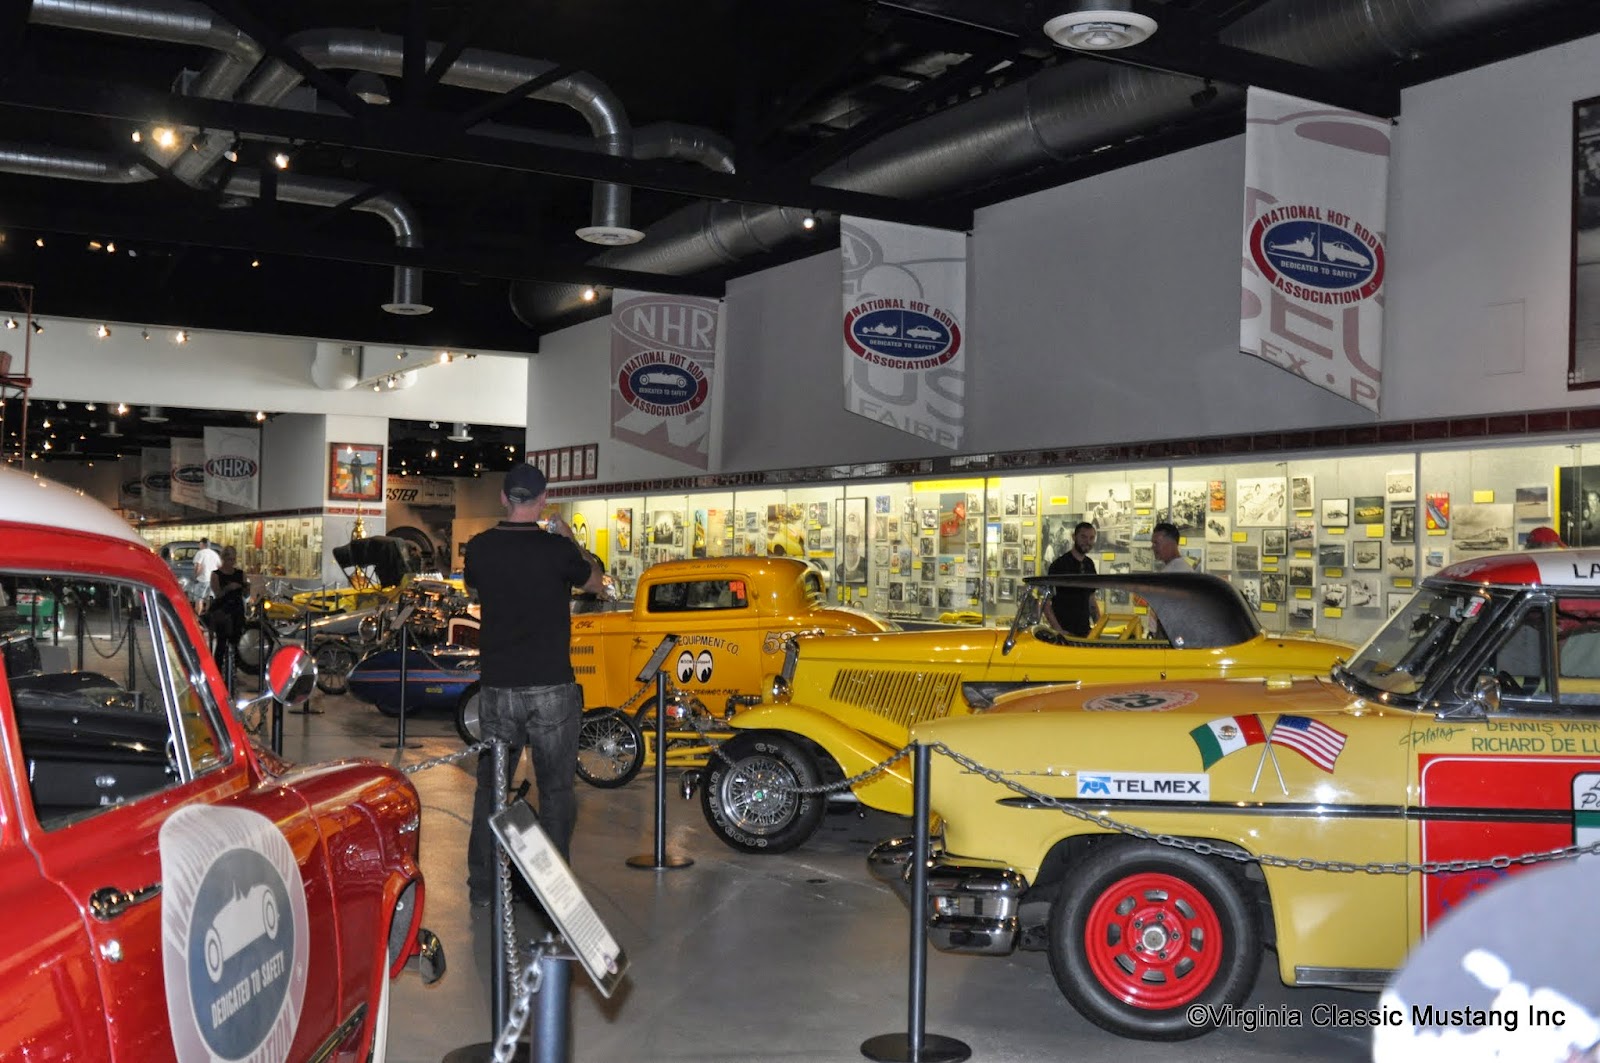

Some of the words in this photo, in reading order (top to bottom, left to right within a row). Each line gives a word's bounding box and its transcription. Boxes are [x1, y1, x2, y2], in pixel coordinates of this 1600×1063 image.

[1260, 205, 1322, 229] NATIONAL
[1327, 210, 1351, 228] HOT
[1354, 222, 1378, 249] ROD
[1280, 260, 1319, 274] DEDICATED
[1321, 266, 1330, 276] TO
[1332, 268, 1357, 280] SAFETY
[1275, 277, 1362, 305] ASSOCIATION
[852, 299, 905, 317] NATIONAL
[910, 300, 931, 314] HOT
[933, 308, 953, 328] ROD
[869, 339, 902, 348] DEDICATED
[914, 342, 936, 351] SAFETY
[624, 352, 666, 375] NATIONAL
[669, 354, 687, 367] HOT
[687, 363, 704, 381] ROD
[864, 352, 940, 370] ASSOCIATION
[632, 398, 691, 417] ASSOCIATION
[213, 459, 250, 477] NHRA
[677, 635, 726, 649] EQUIPMENT
[1486, 722, 1554, 733] DENNIS
[1471, 737, 1545, 752] RICHARD
[1551, 738, 1577, 752] DE
[1113, 779, 1202, 794] TELMEX
[211, 976, 251, 1030] DEDICATED
[250, 970, 262, 997] TO
[261, 949, 286, 986] SAFETY
